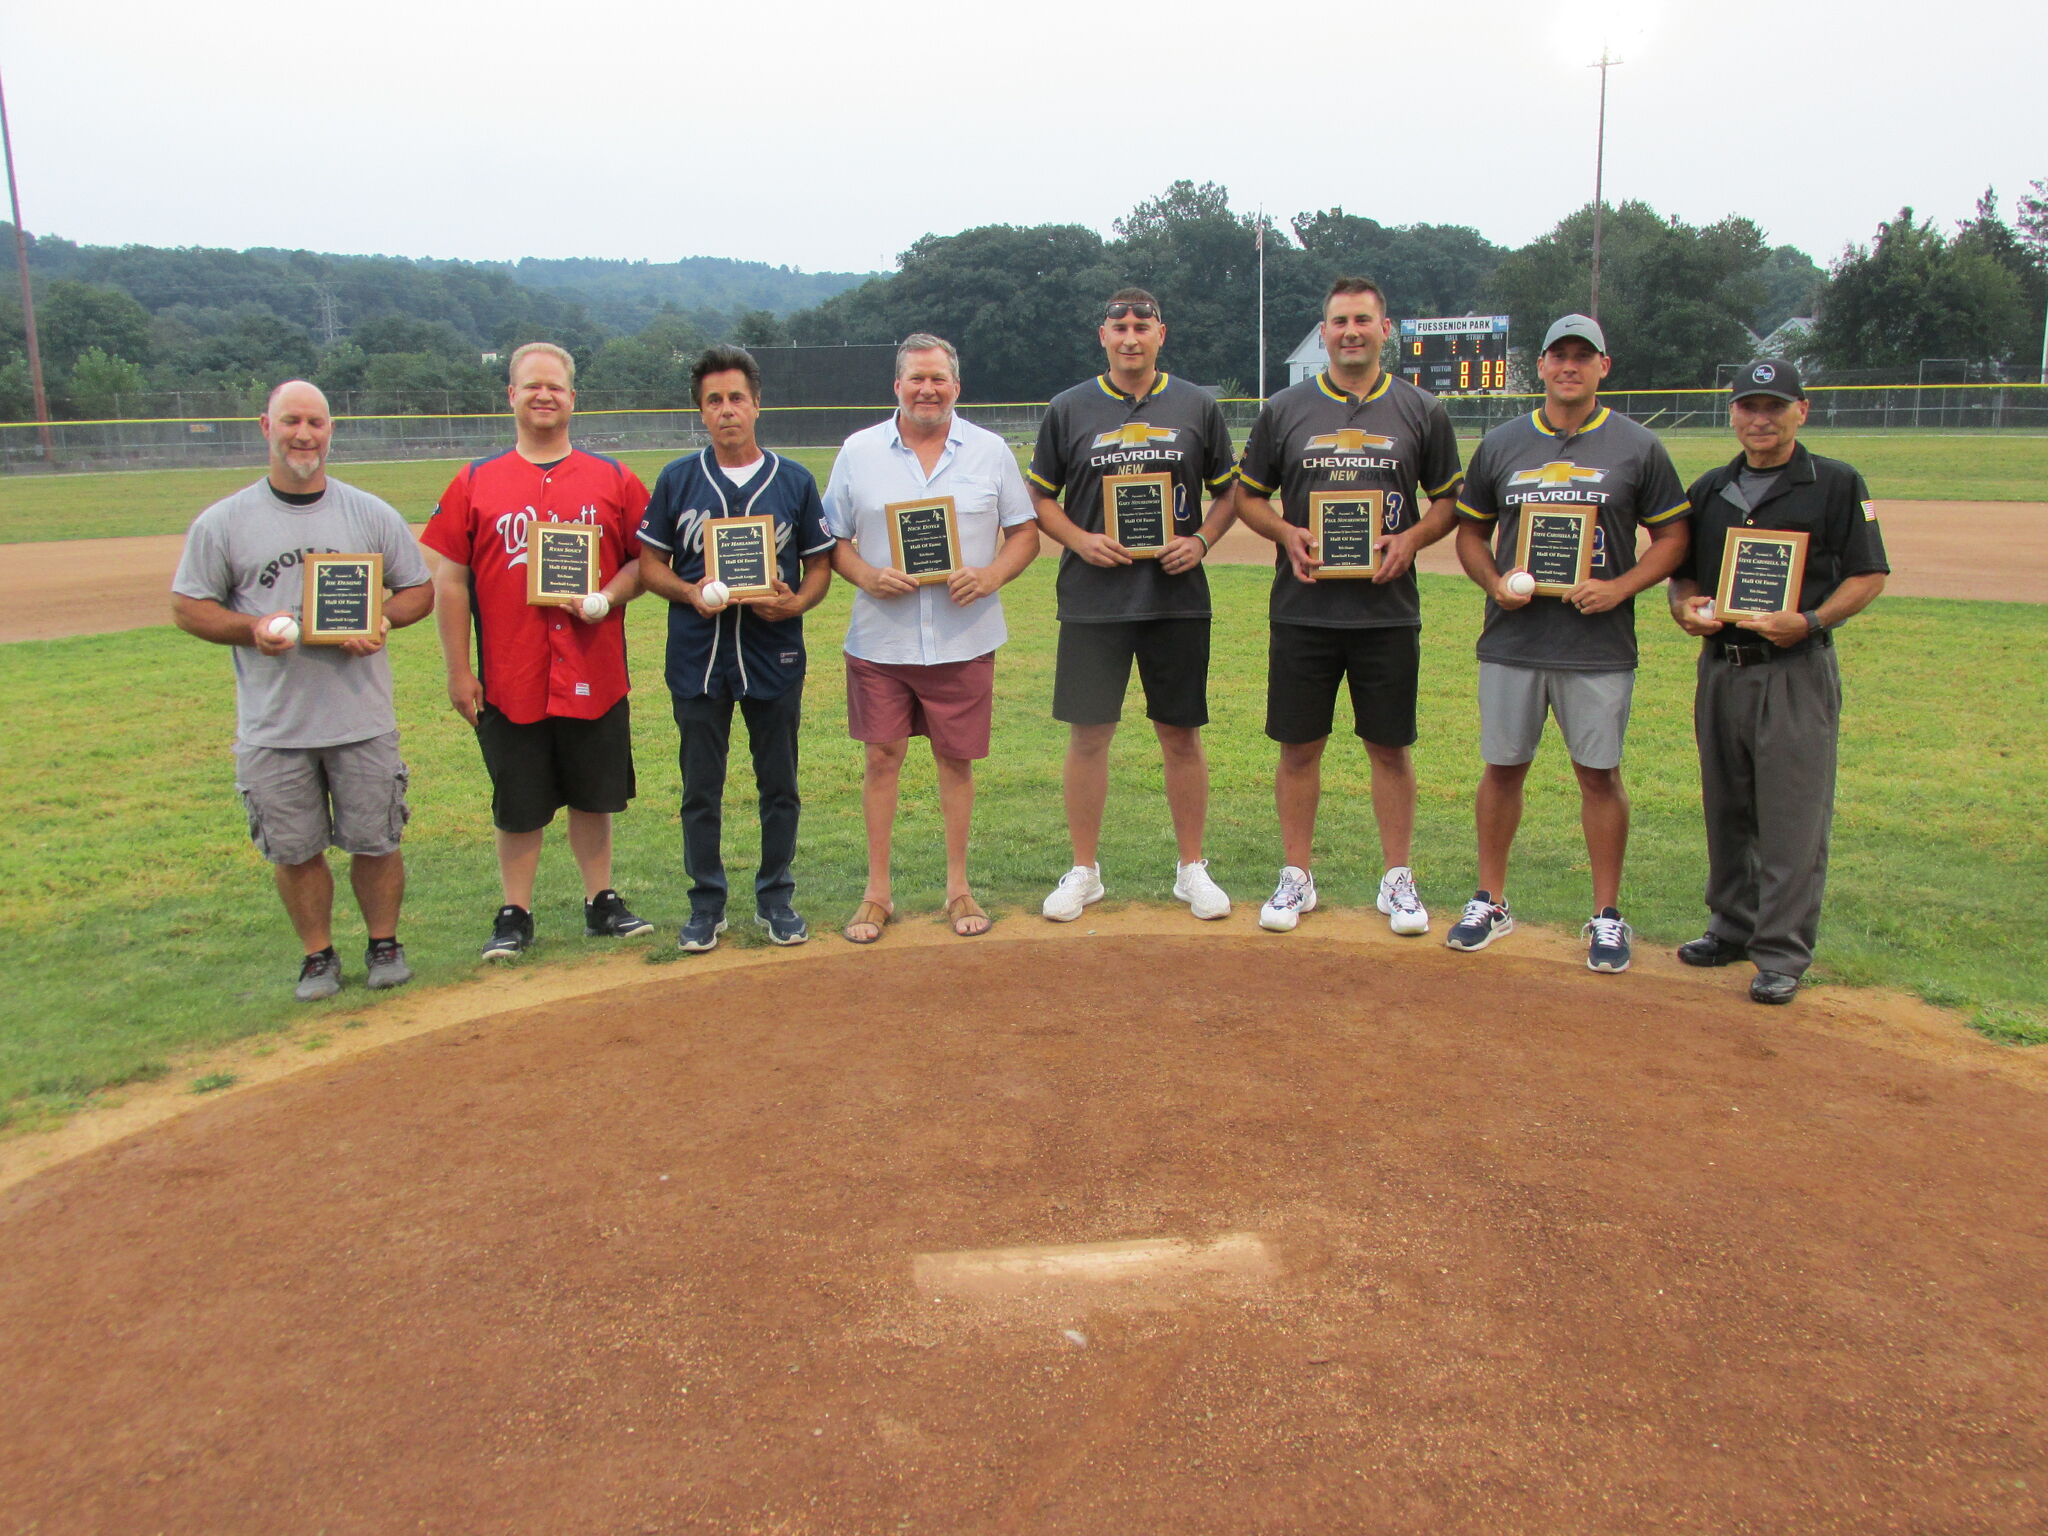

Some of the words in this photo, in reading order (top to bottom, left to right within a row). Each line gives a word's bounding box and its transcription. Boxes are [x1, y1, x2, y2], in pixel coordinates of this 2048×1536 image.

[1417, 321, 1467, 331] FUESSENICH
[1469, 320, 1491, 329] PARK
[1413, 342, 1421, 355] 0
[1460, 361, 1469, 375] 0
[1482, 361, 1490, 374] 0
[1496, 360, 1504, 374] 0
[1460, 375, 1468, 388] 0
[1495, 374, 1504, 388] 0
[1091, 449, 1184, 467] CHEVROLET
[1302, 457, 1399, 470] CHEVROLET
[1118, 463, 1144, 475] NEW
[1329, 470, 1358, 481] NEW
[1505, 491, 1610, 505] CHEVROLET
[1385, 491, 1403, 531] 3
